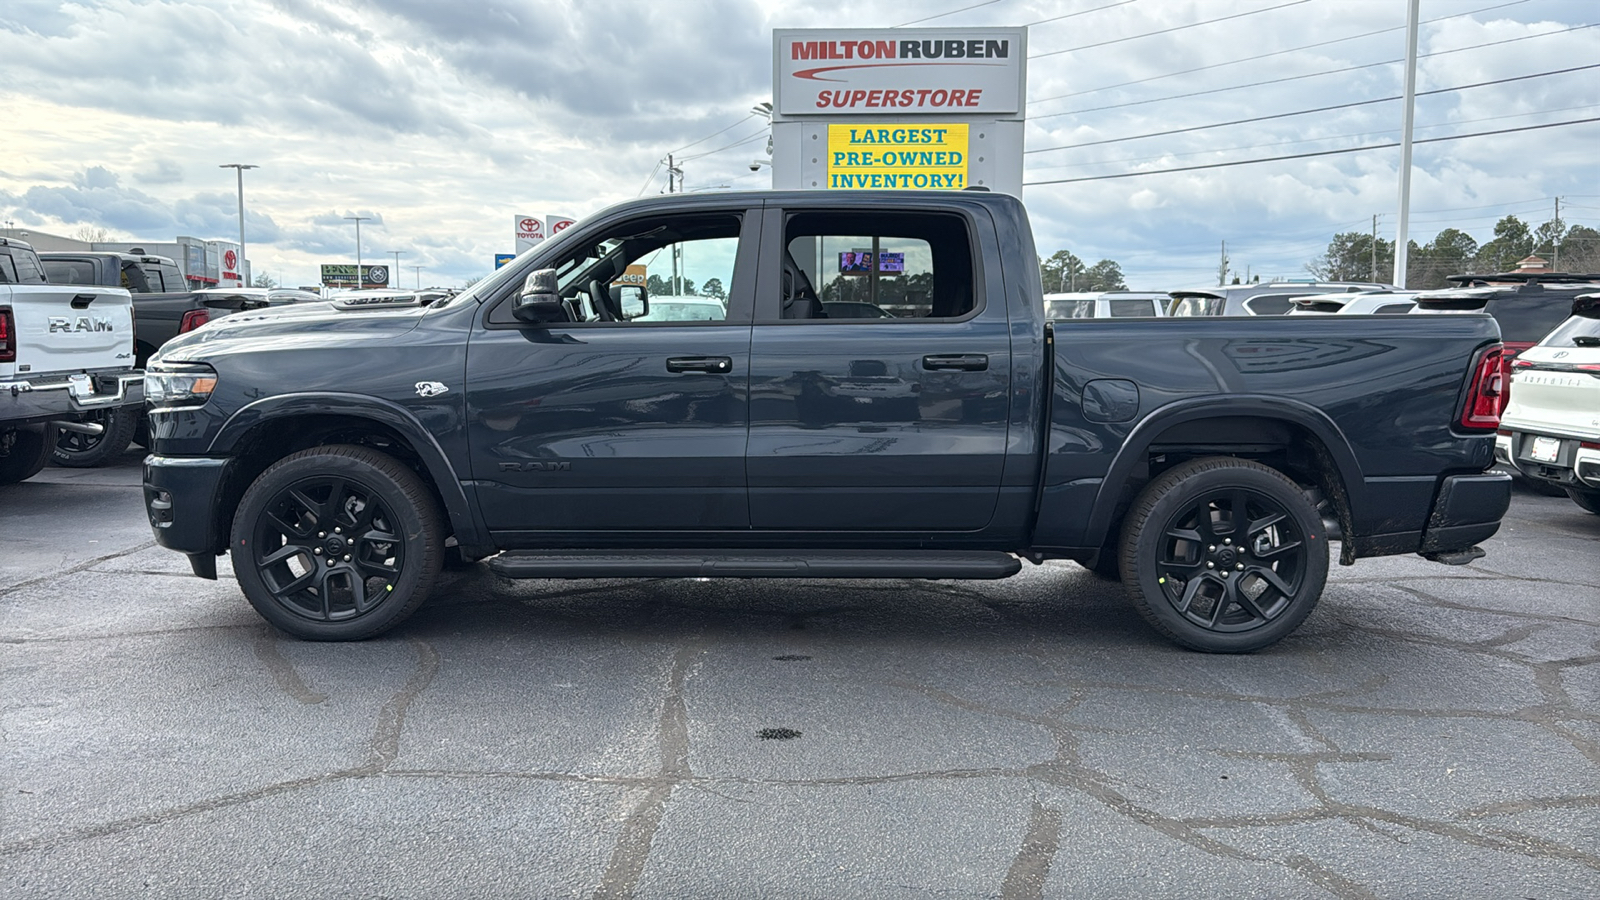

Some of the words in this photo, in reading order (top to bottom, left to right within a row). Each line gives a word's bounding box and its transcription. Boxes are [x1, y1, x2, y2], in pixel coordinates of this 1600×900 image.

[791, 40, 896, 60] MILTON
[899, 40, 1009, 59] RUBEN
[816, 89, 983, 108] SUPERSTORE
[849, 129, 948, 145] LARGEST
[832, 151, 963, 167] PRE-OWNED
[831, 174, 964, 189] INVENTORY!
[48, 316, 113, 333] RAM
[498, 461, 571, 473] RAM
